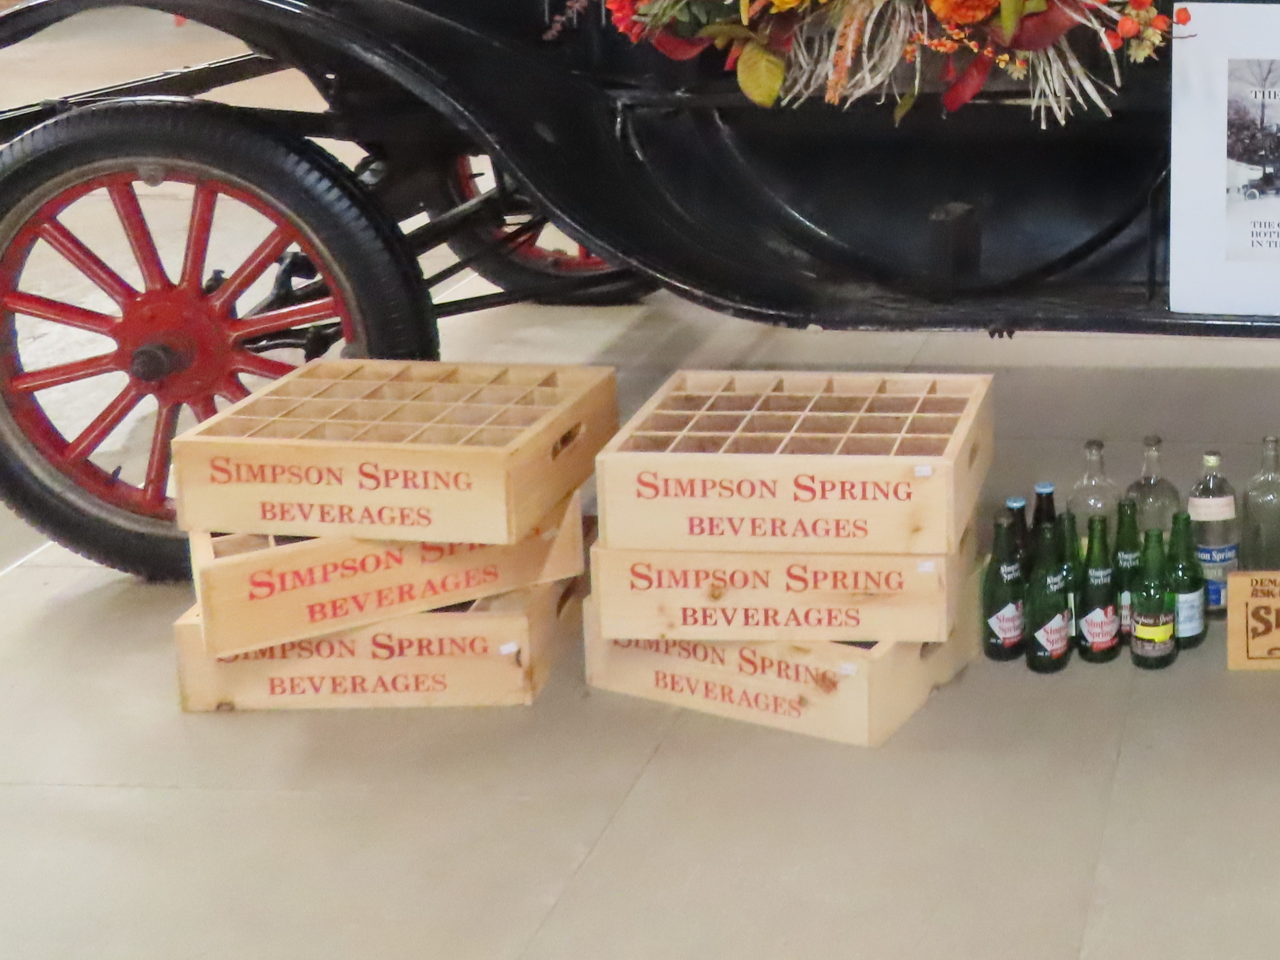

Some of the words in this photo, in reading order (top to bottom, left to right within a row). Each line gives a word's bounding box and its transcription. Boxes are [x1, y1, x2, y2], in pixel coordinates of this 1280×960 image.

[1251, 221, 1275, 230] THE
[1251, 239, 1264, 248] IN
[209, 456, 343, 486] SIMPSON
[358, 461, 473, 491] SPRING
[636, 471, 778, 500] SIMPSON
[793, 473, 913, 503] SPRING
[260, 501, 433, 527] BEVERAGES
[687, 516, 869, 539] BEVERAGES
[248, 547, 404, 601] SIMPSON
[629, 562, 771, 591] SIMPSON
[785, 563, 904, 593] SPRING
[306, 563, 499, 625] BEVERAGES
[1251, 588, 1276, 598] ASK
[681, 607, 861, 628] BEVERAGES
[371, 633, 489, 661] SPRING
[738, 646, 838, 691] SPRING
[268, 674, 448, 696] BEVERAGES
[653, 669, 801, 718] BEVERAGES
